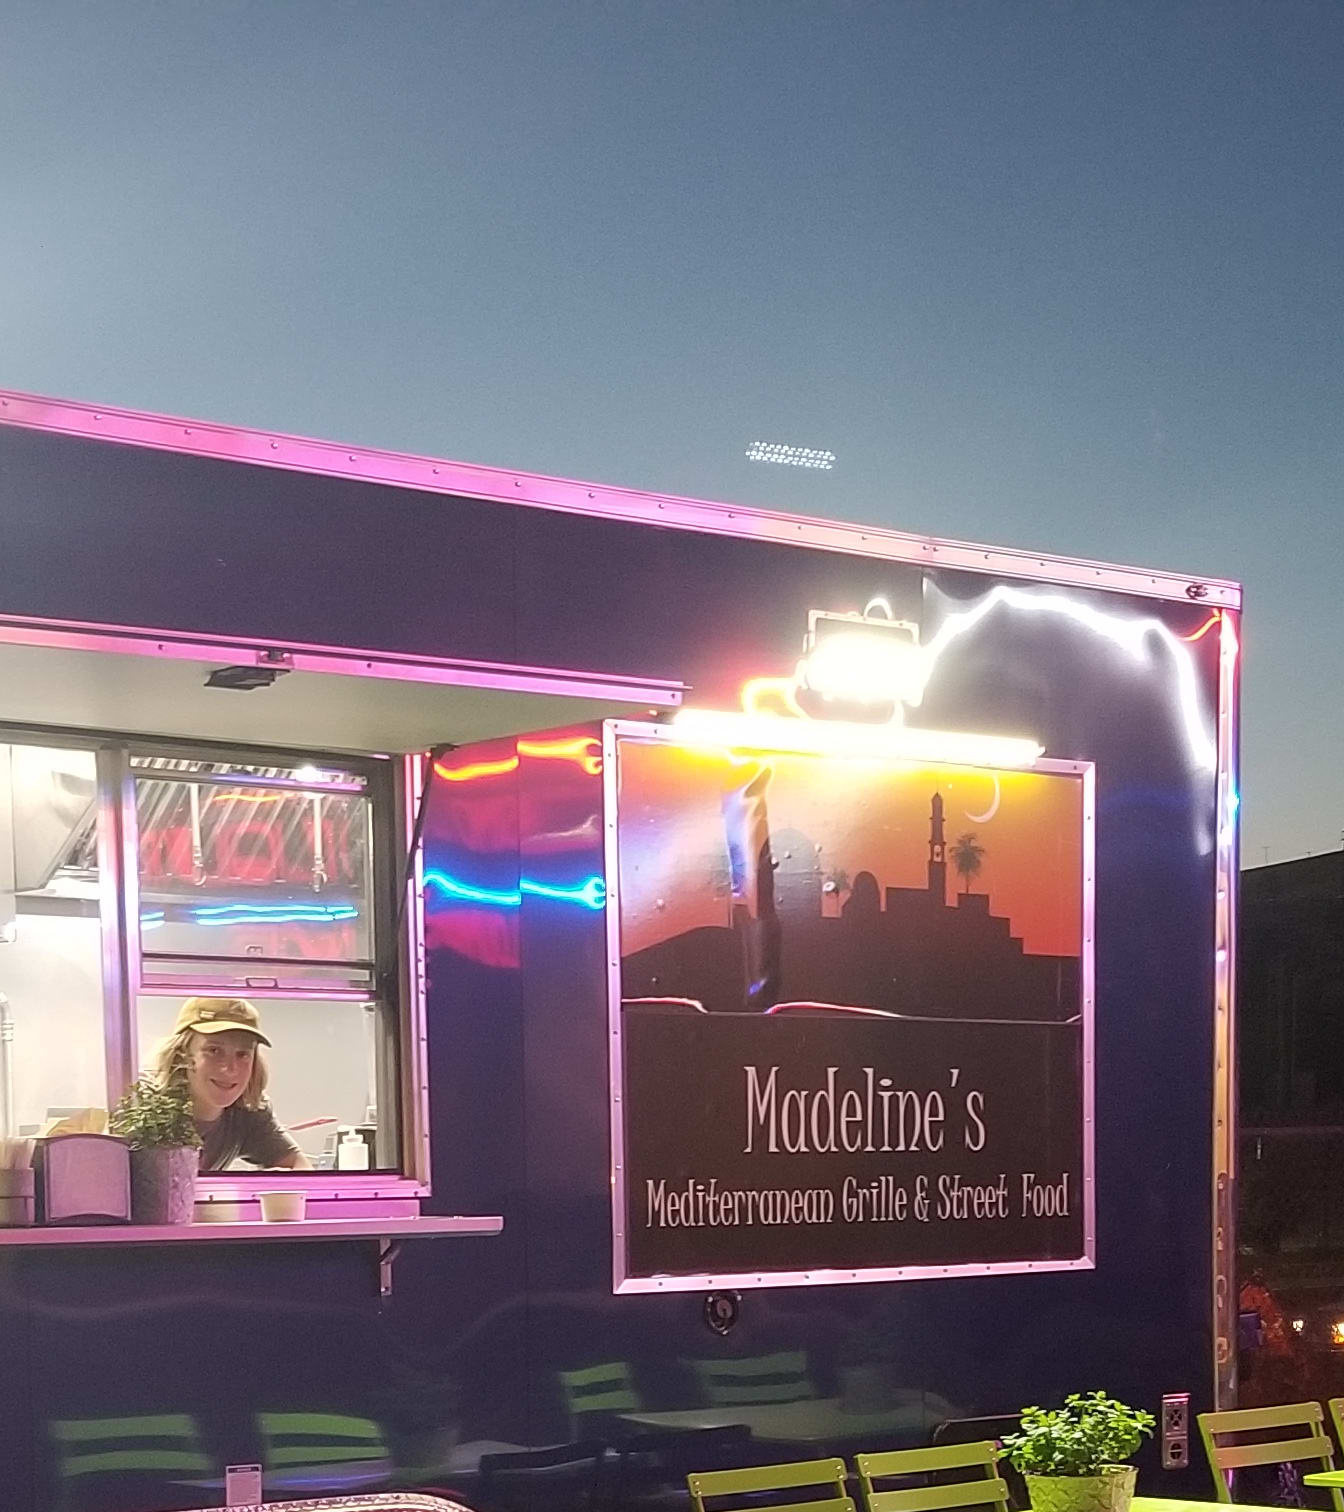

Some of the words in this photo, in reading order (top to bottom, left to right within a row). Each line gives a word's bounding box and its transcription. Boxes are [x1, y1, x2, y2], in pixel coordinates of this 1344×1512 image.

[742, 1065, 987, 1154] Madeline's
[645, 1177, 835, 1229] Mediterranean
[841, 1175, 909, 1225] Grille
[913, 1176, 930, 1224] &
[937, 1173, 1010, 1220] Street
[1020, 1172, 1071, 1219] Food
